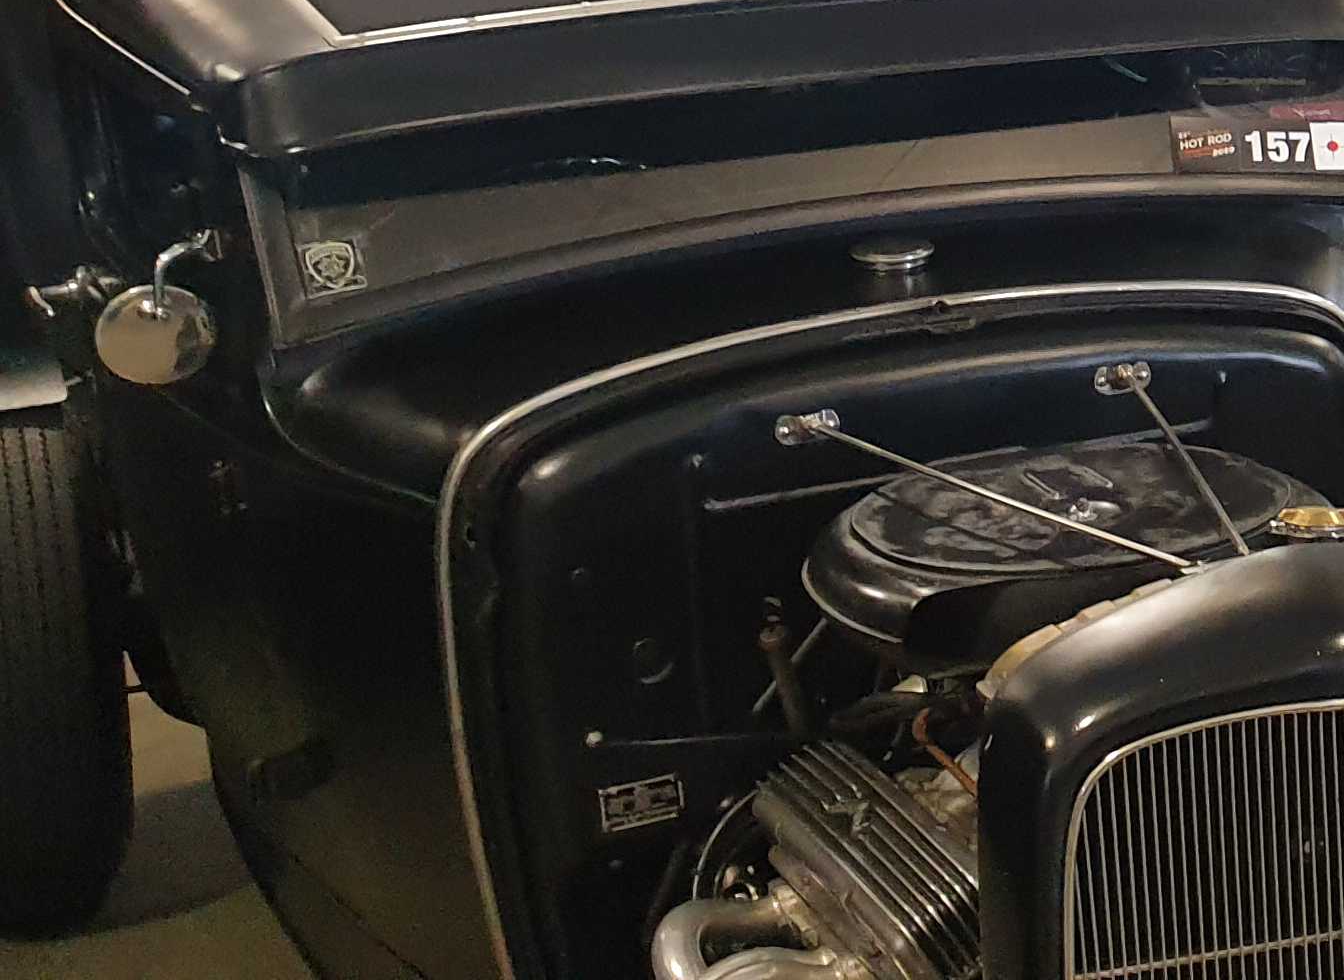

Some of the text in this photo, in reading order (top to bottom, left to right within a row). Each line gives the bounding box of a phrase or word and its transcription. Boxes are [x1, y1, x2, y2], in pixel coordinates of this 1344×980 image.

[1180, 137, 1204, 151] HOT
[1207, 133, 1232, 147] ROD
[1244, 130, 1311, 163] 157
